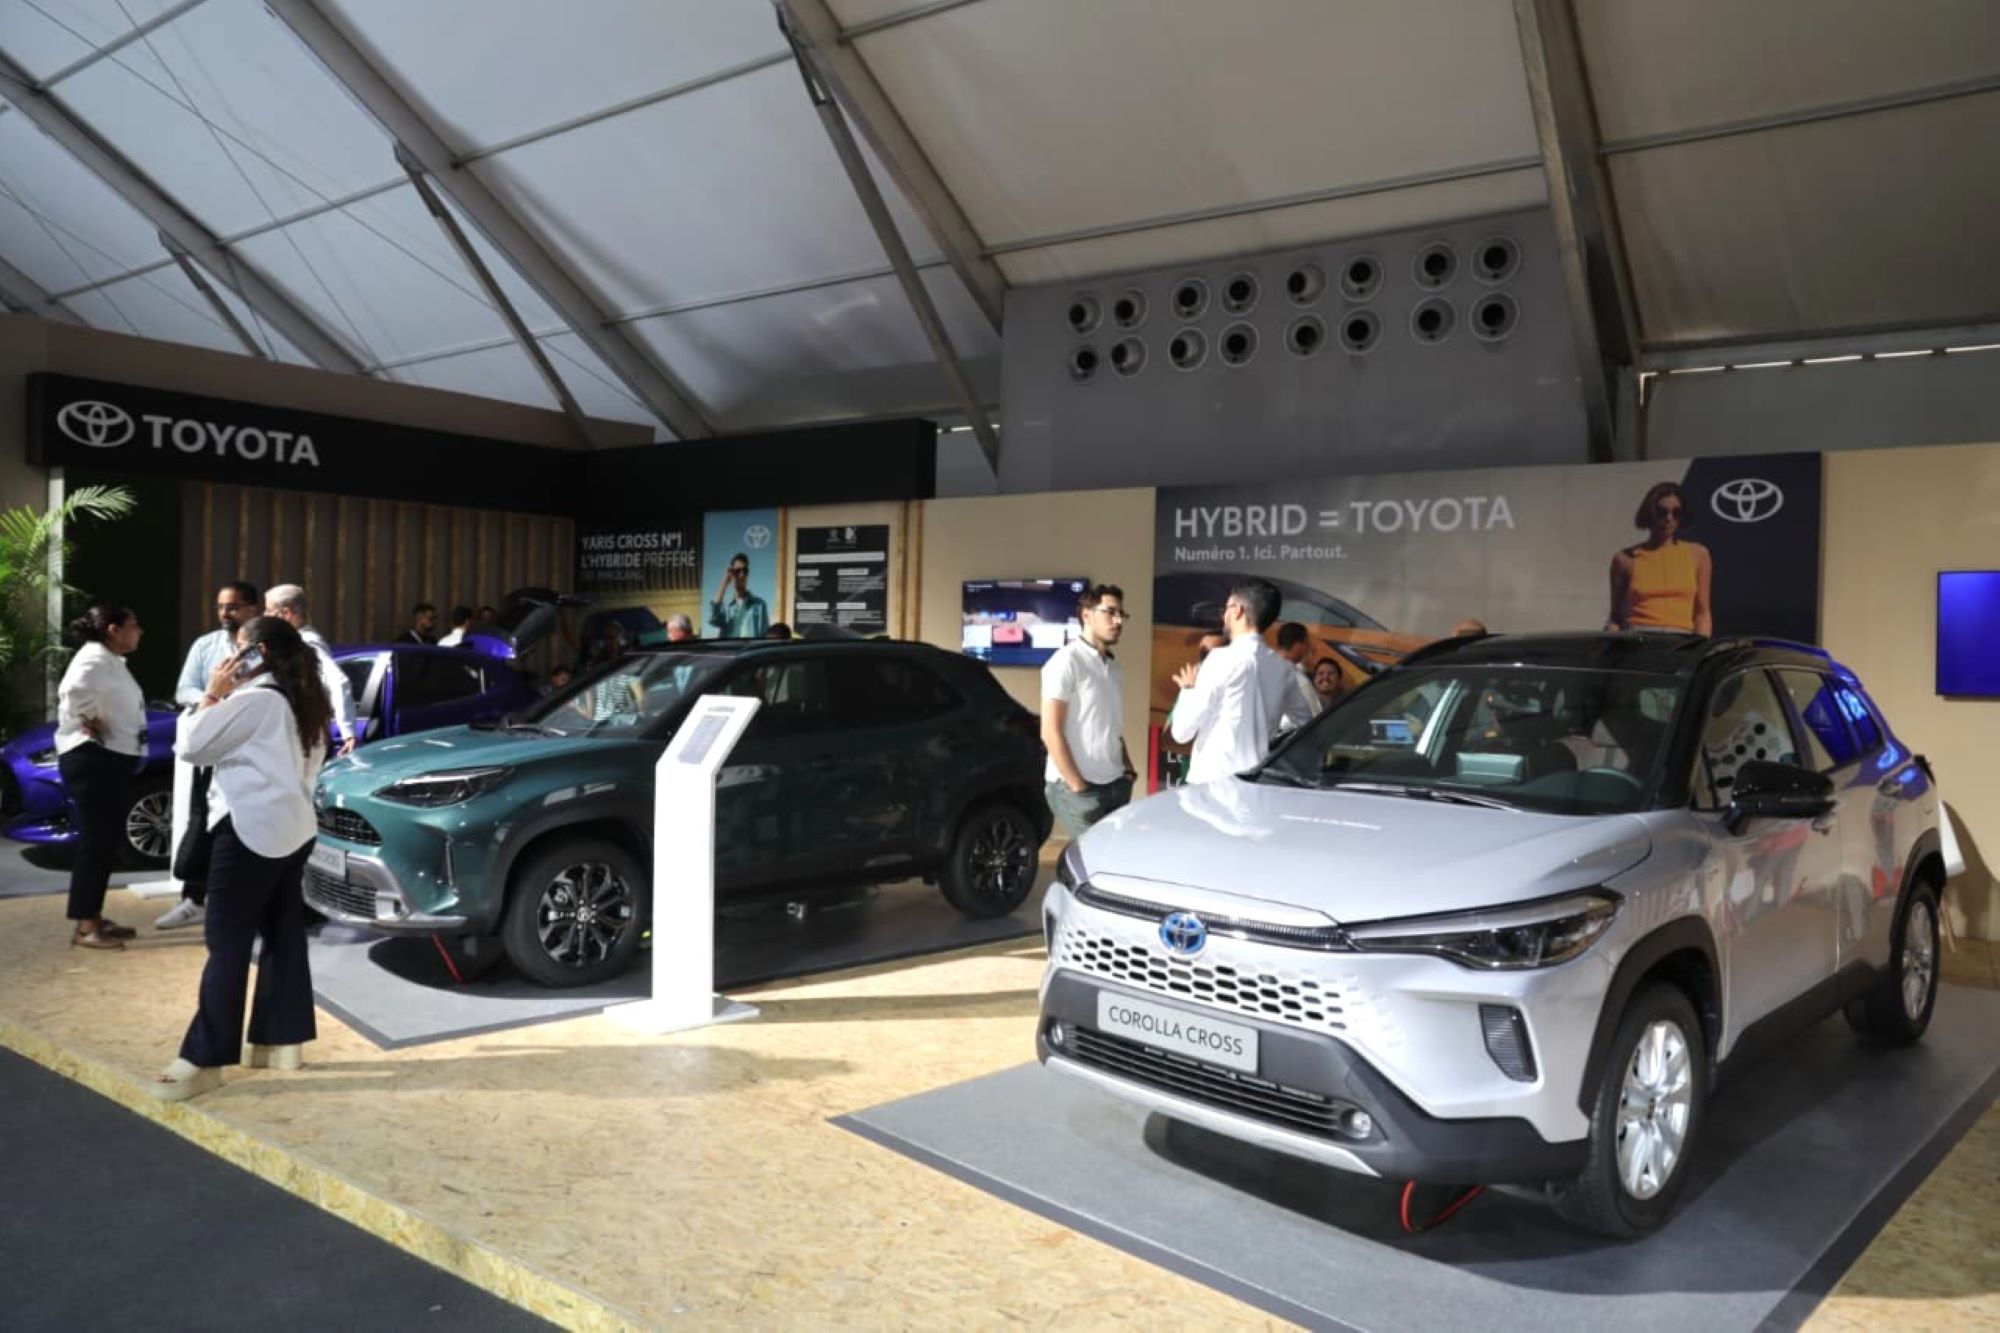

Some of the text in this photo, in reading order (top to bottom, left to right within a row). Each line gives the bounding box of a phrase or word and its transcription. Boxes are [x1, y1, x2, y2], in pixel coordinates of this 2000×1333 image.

[142, 414, 320, 467] TOYOTA
[1174, 496, 1516, 538] HYBRID = TOYOTA
[581, 535, 615, 550] YARIS
[617, 532, 659, 549] CROSS
[1174, 543, 1348, 562] Numéro 1. Ici. Partout.
[581, 551, 641, 569] L'HYBRIDE
[1108, 1005, 1244, 1056] COROLLA CROSS
